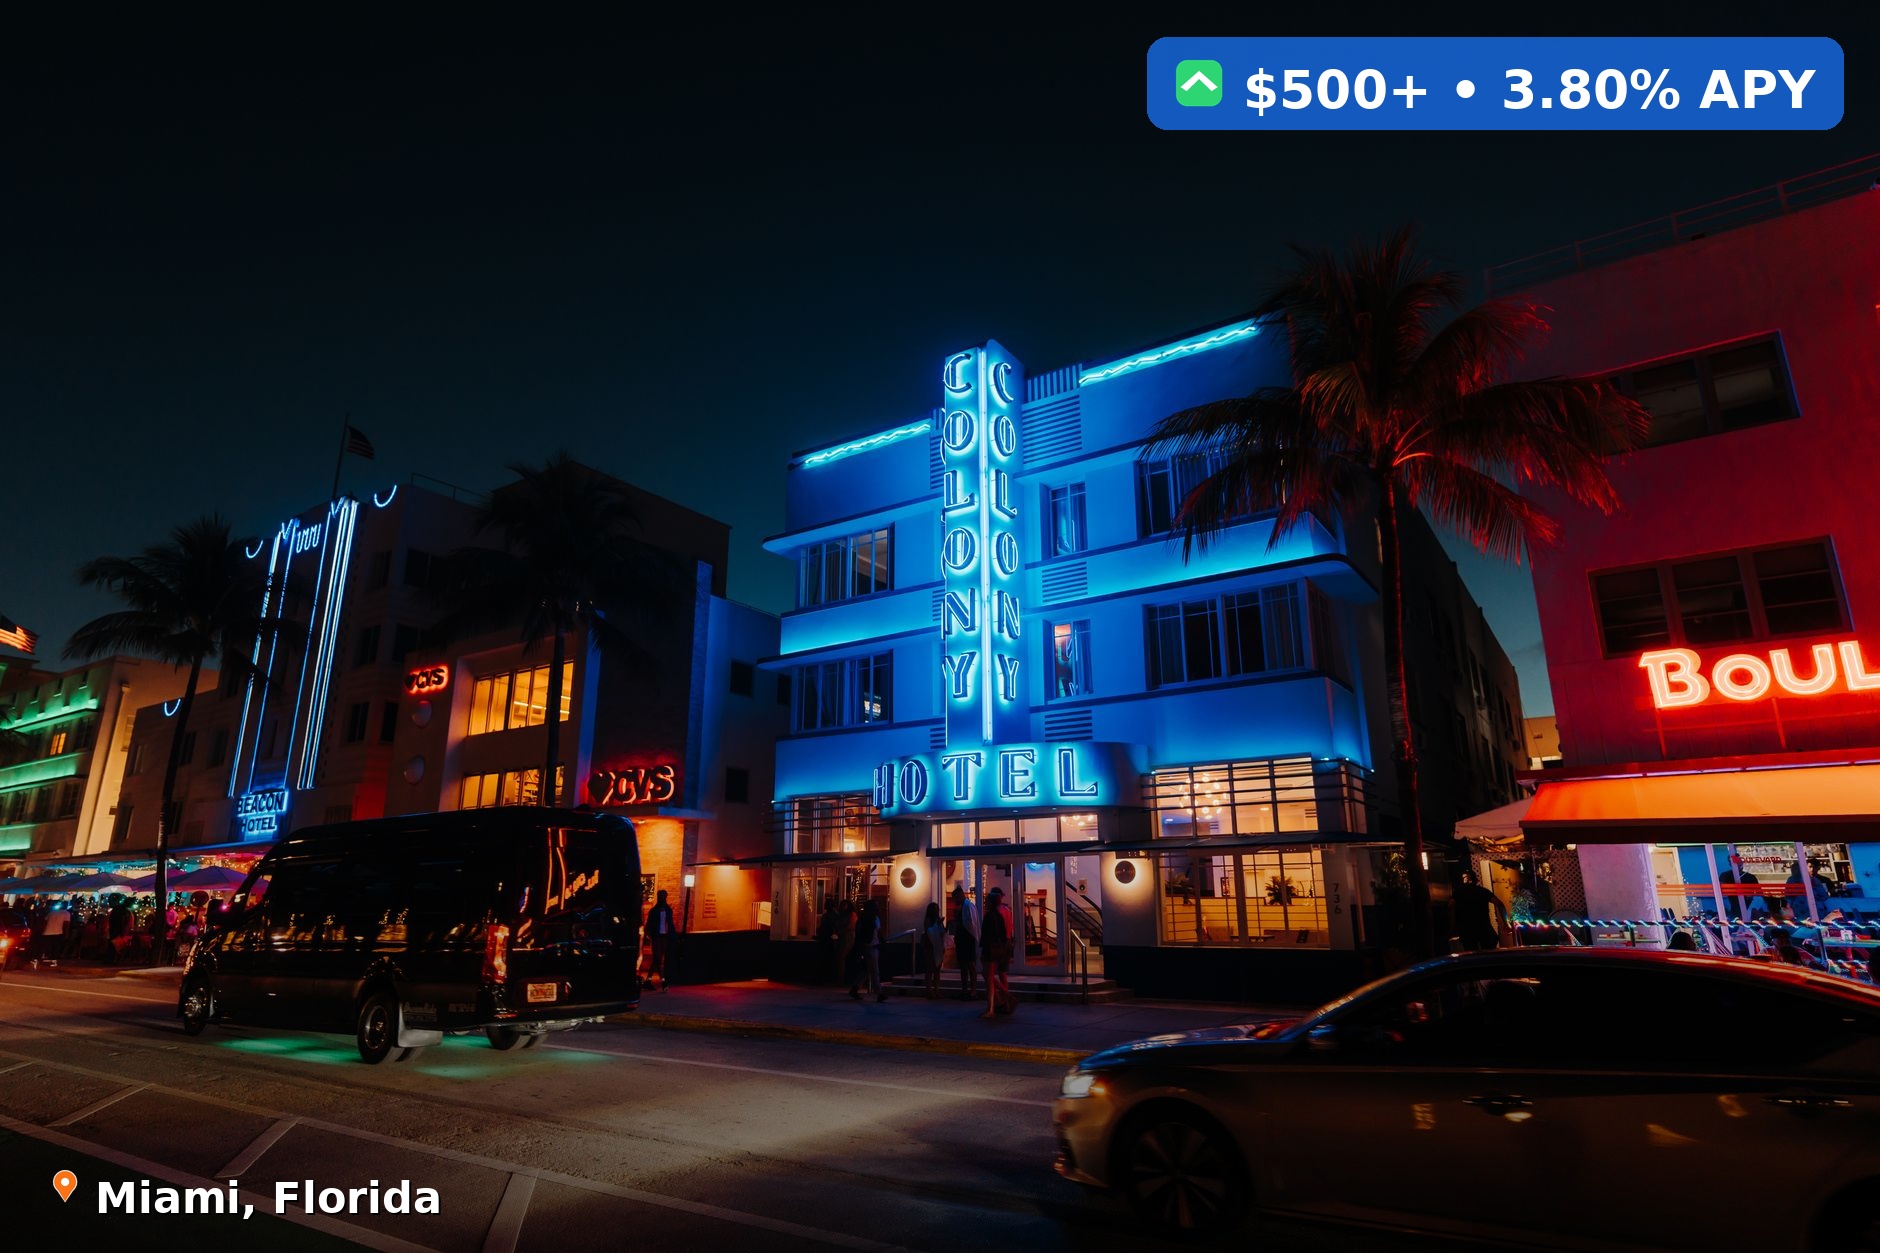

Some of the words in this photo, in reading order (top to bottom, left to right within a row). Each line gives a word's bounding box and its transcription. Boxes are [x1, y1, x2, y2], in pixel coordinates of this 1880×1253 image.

[943, 353, 976, 698] COLONY
[993, 362, 1020, 701] COLONY
[416, 668, 446, 689] CVS
[1638, 640, 1880, 709] BOUL
[614, 766, 675, 804] CVS
[873, 748, 1098, 810] HOTEL
[237, 792, 285, 814] BEACON
[241, 817, 276, 832] HOTEL
[1332, 882, 1342, 914] 736
